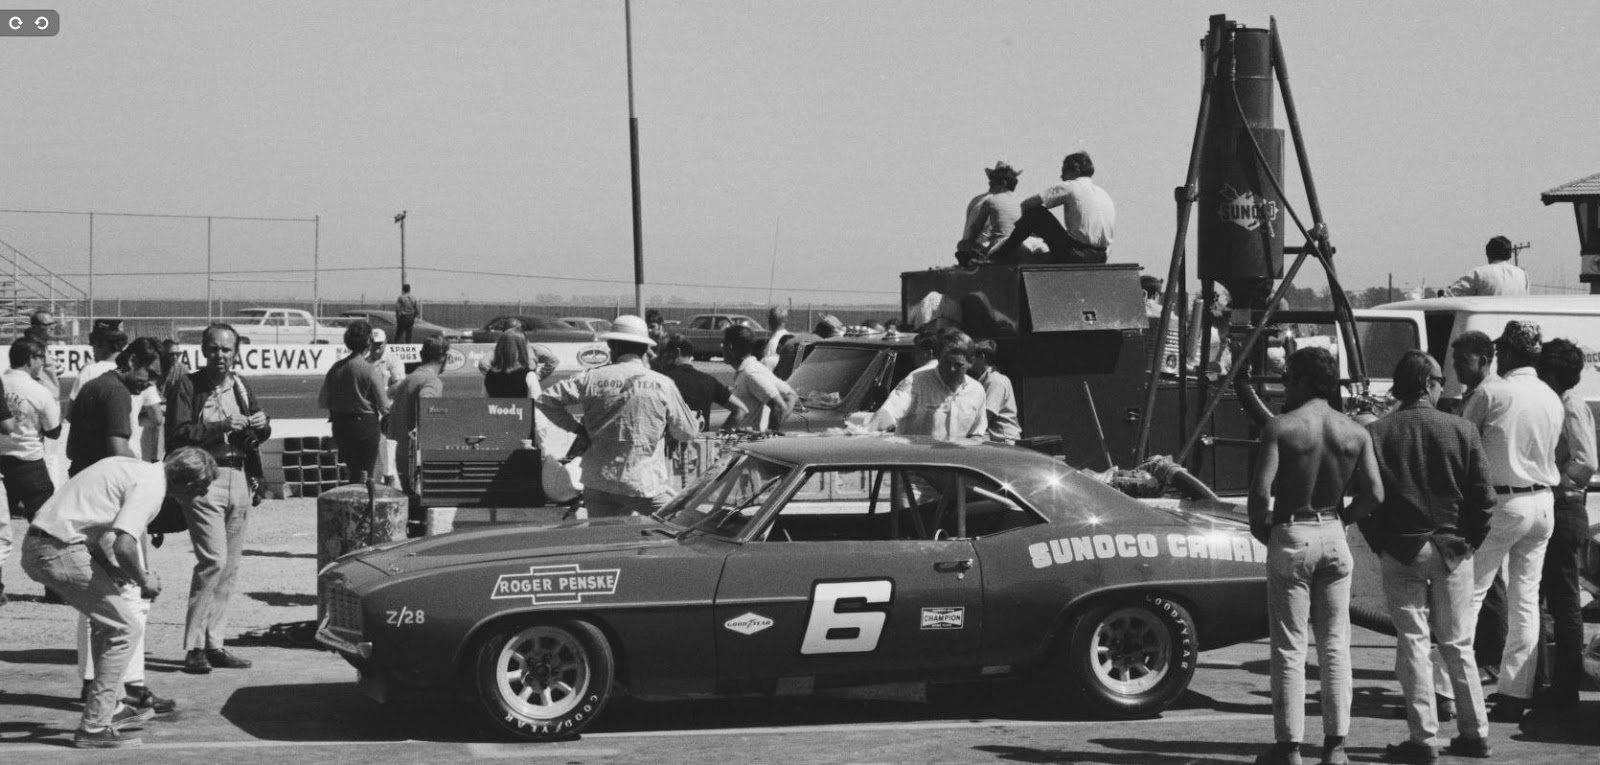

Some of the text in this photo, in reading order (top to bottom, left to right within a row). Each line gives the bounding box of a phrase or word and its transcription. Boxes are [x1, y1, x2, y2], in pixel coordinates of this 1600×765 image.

[1220, 204, 1276, 219] SUNOO
[232, 349, 323, 369] ACEWAY
[487, 403, 523, 420] Woody
[1028, 533, 1267, 569] SUNOCO CAMAR
[499, 575, 615, 593] ROGER PENSKE
[385, 606, 425, 628] Z/28
[800, 580, 892, 655] 6
[924, 614, 961, 622] CHAMPION
